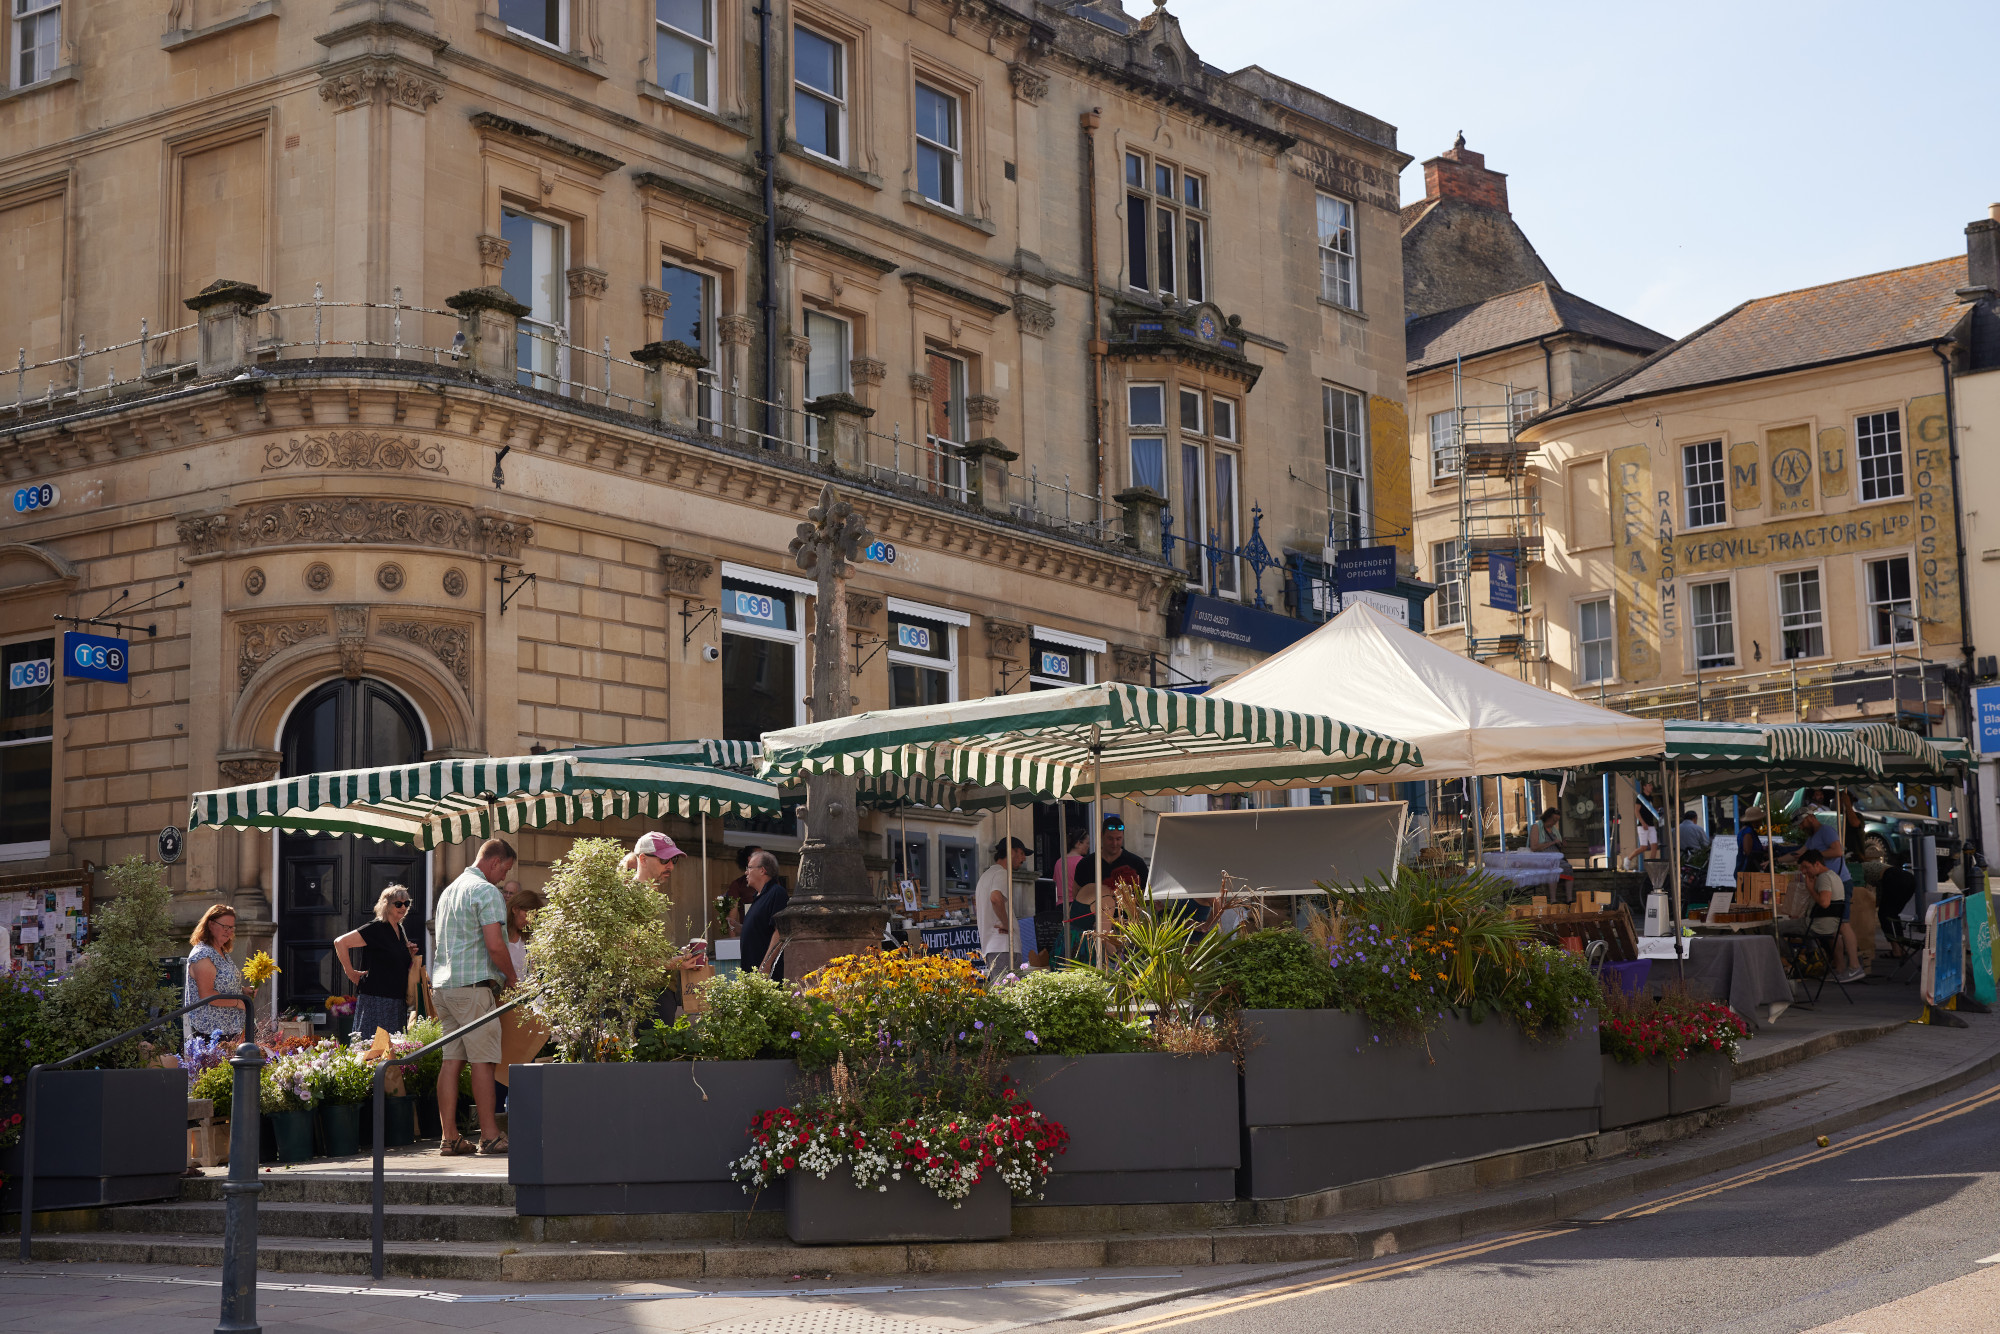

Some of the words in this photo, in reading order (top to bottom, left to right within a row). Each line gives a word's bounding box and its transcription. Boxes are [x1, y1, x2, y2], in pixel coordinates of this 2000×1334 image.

[1822, 448, 1844, 475] U
[1733, 462, 1758, 490] M
[16, 485, 51, 508] TSB
[1779, 498, 1810, 511] RAC
[1915, 448, 1939, 600] FORDSON
[1684, 537, 1759, 563] YEOVIL
[1767, 520, 1872, 552] TRACTORS
[1882, 514, 1910, 535] LTD
[867, 543, 895, 561] TSB
[1340, 558, 1392, 569] INDEPENDENT
[1619, 462, 1648, 665] REPAIRS
[1657, 489, 1676, 639] RANSOMES
[1346, 568, 1387, 579] OPTICIANS
[739, 598, 770, 615] TSB
[900, 628, 927, 645] TSB
[79, 647, 121, 668] TSB
[1044, 657, 1068, 673] TSB
[13, 664, 48, 684] TSB
[166, 838, 174, 850] 2
[922, 932, 949, 949] WHITE
[949, 930, 971, 946] LAKE
